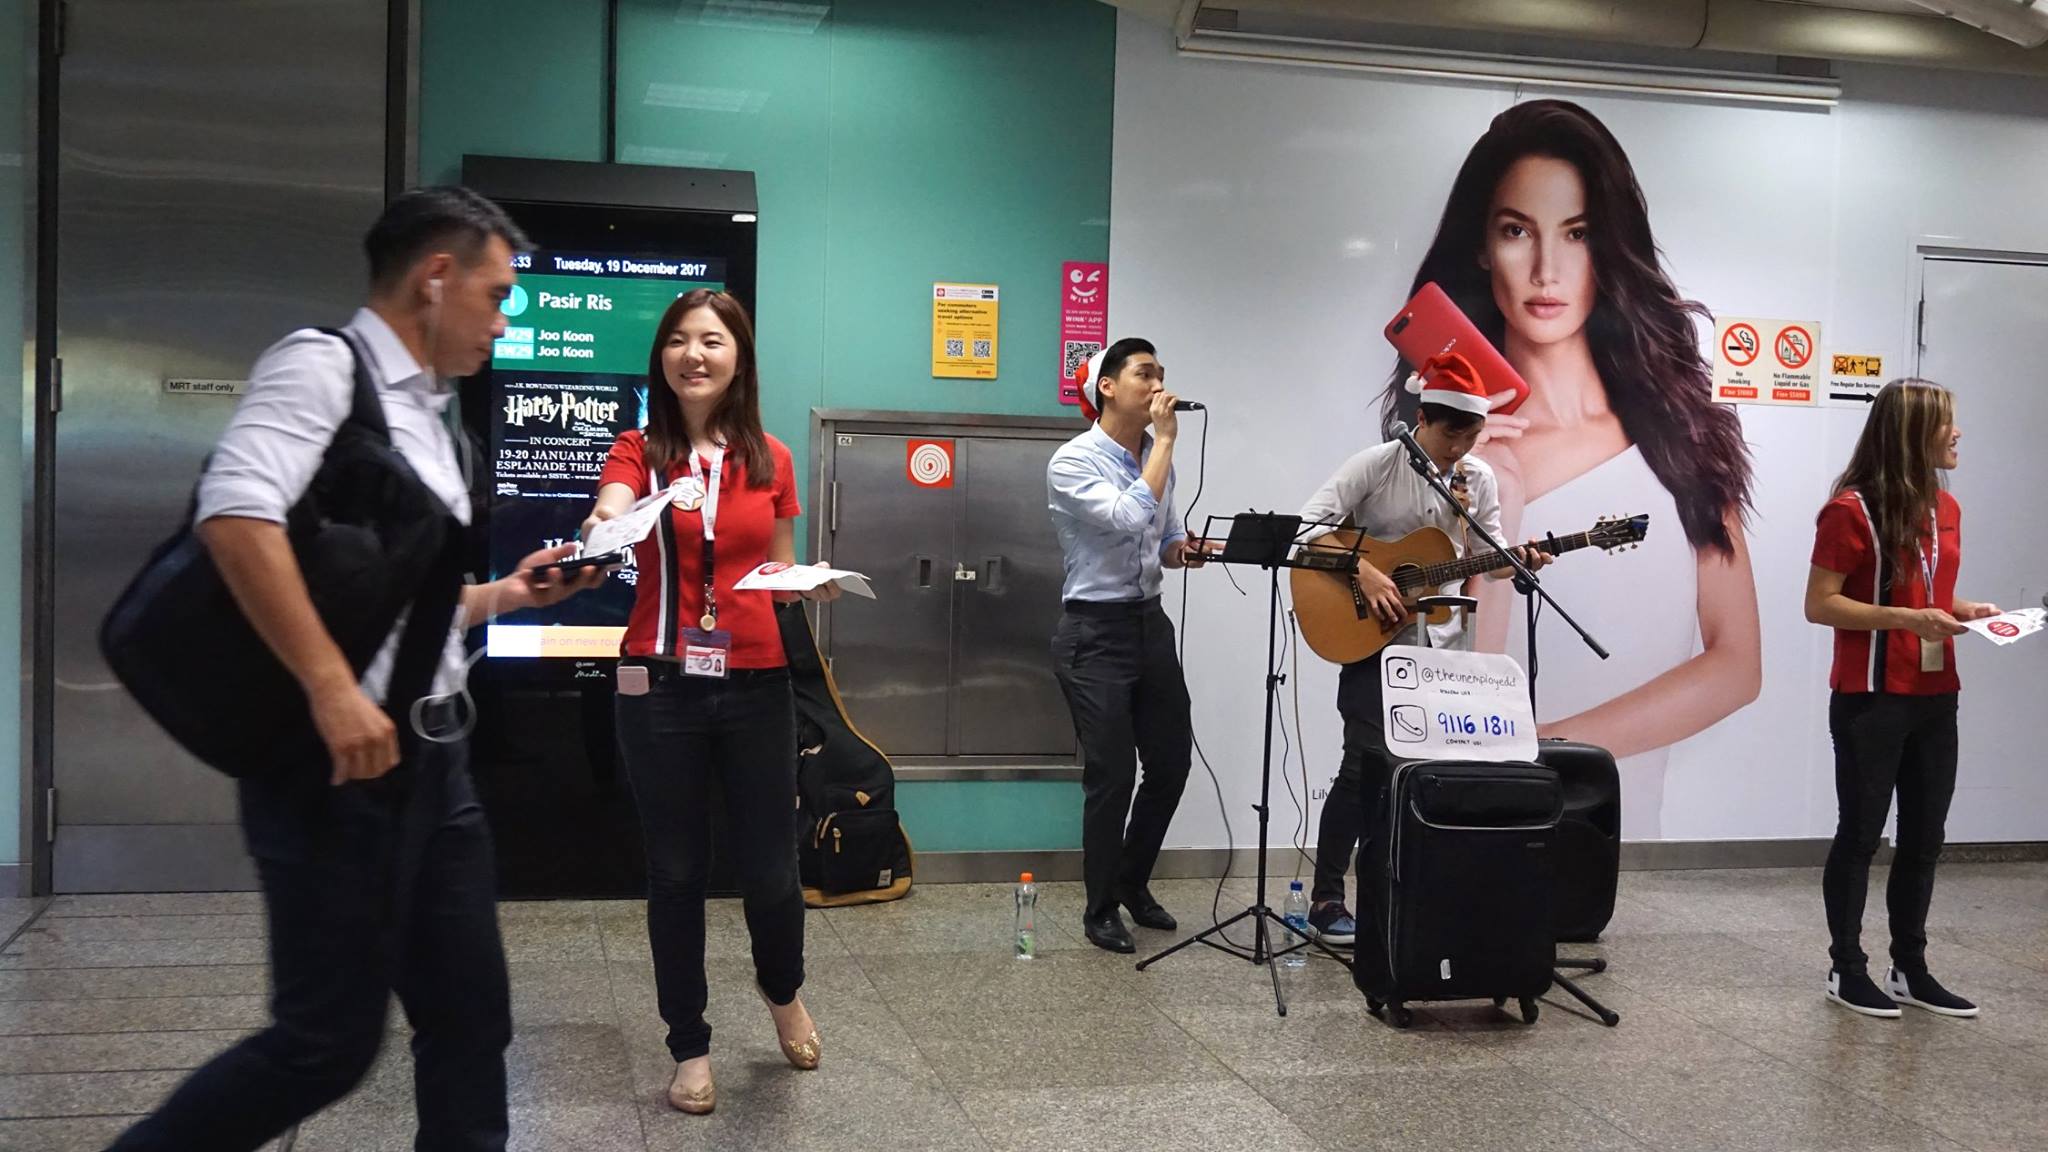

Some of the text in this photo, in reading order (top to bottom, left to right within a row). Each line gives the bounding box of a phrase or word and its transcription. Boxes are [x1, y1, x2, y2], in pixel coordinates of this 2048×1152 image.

[554, 257, 707, 276] Tuesday, 19 December 2017
[538, 291, 613, 311] Pasir Ris
[537, 329, 561, 341] Joo
[562, 330, 595, 343] Koon
[537, 345, 561, 357] Joo
[562, 346, 595, 359] Koon
[169, 381, 235, 393] MRT staff only
[1728, 378, 1751, 386] Smoking
[503, 391, 620, 430] Harry Potter
[529, 436, 592, 447] IN CONCERT
[499, 449, 530, 460] 19-20
[531, 450, 594, 461] JANUARY
[495, 460, 567, 471] ESPLANADE
[1437, 712, 1515, 737] 9116 1811
